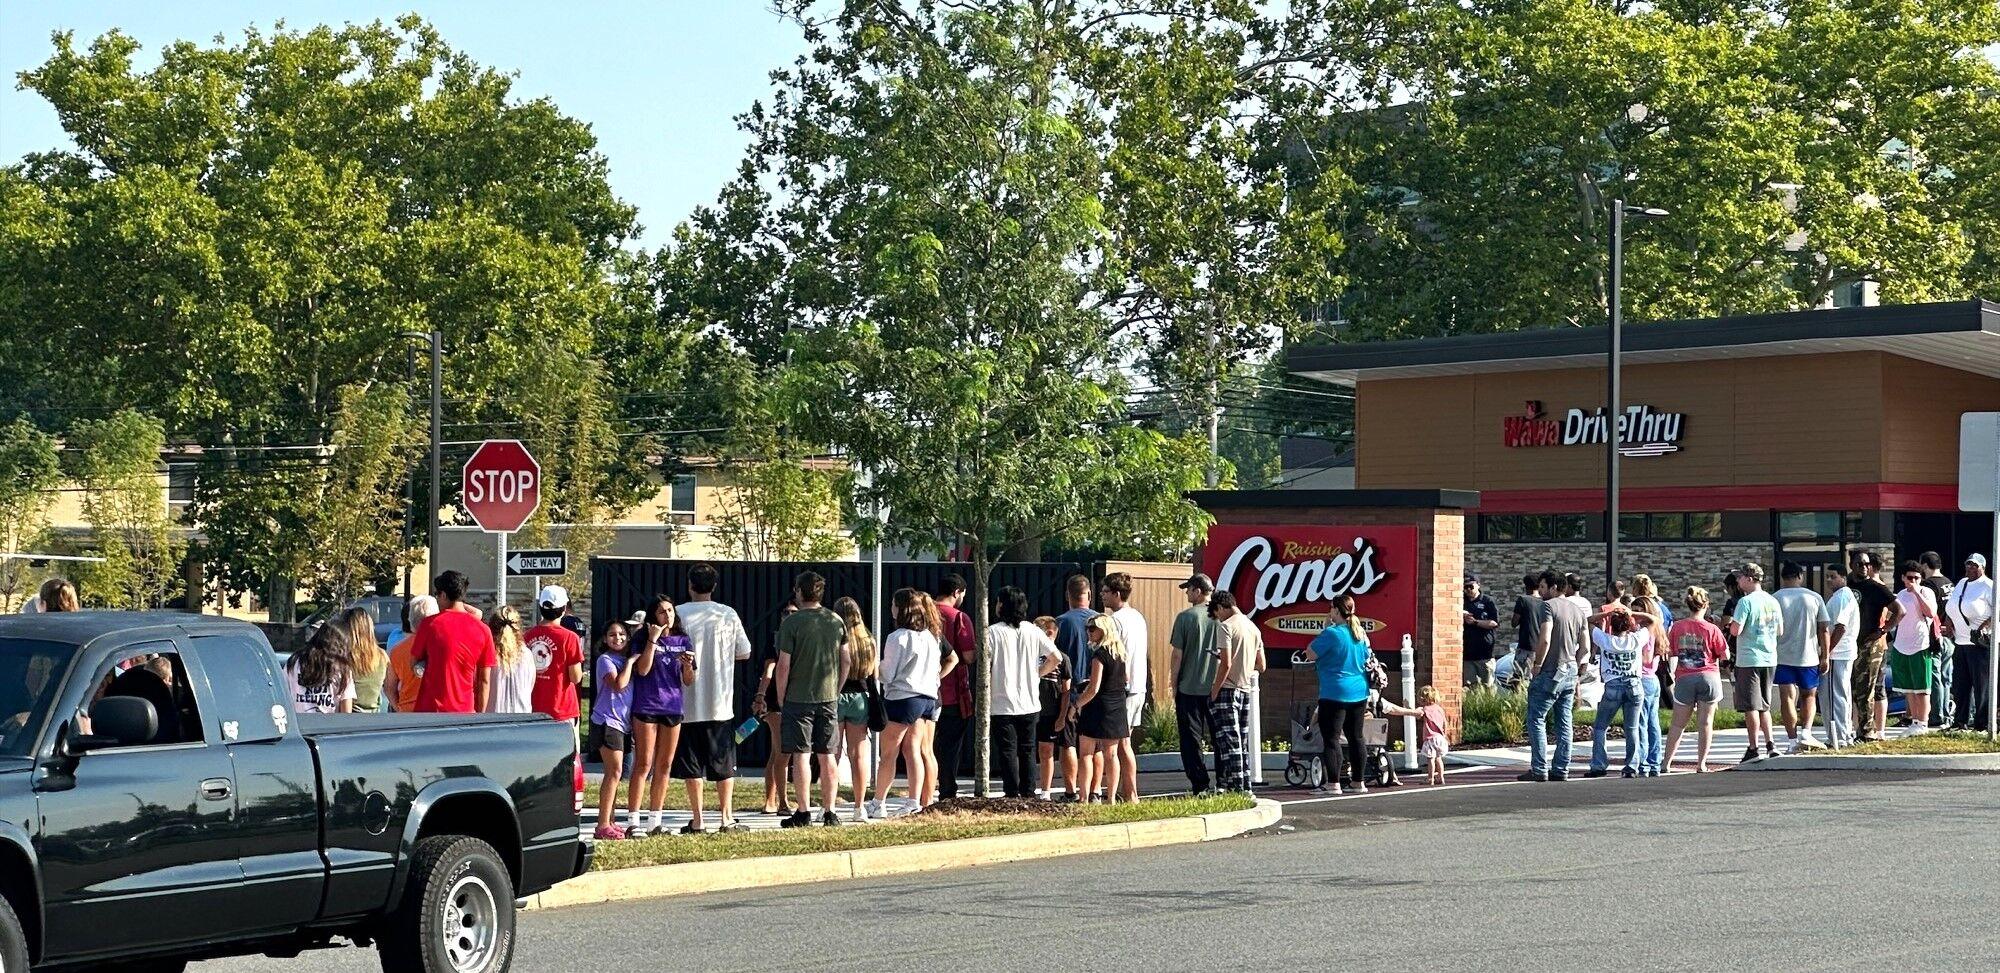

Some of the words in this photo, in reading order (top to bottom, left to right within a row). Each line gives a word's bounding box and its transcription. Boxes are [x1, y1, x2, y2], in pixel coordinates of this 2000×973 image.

[1504, 416, 1560, 447] Wawa
[469, 469, 534, 503] STOP
[520, 558, 538, 569] ONE
[540, 558, 559, 568] WAY
[1215, 536, 1386, 618] Cane's
[545, 636, 558, 651] 2017
